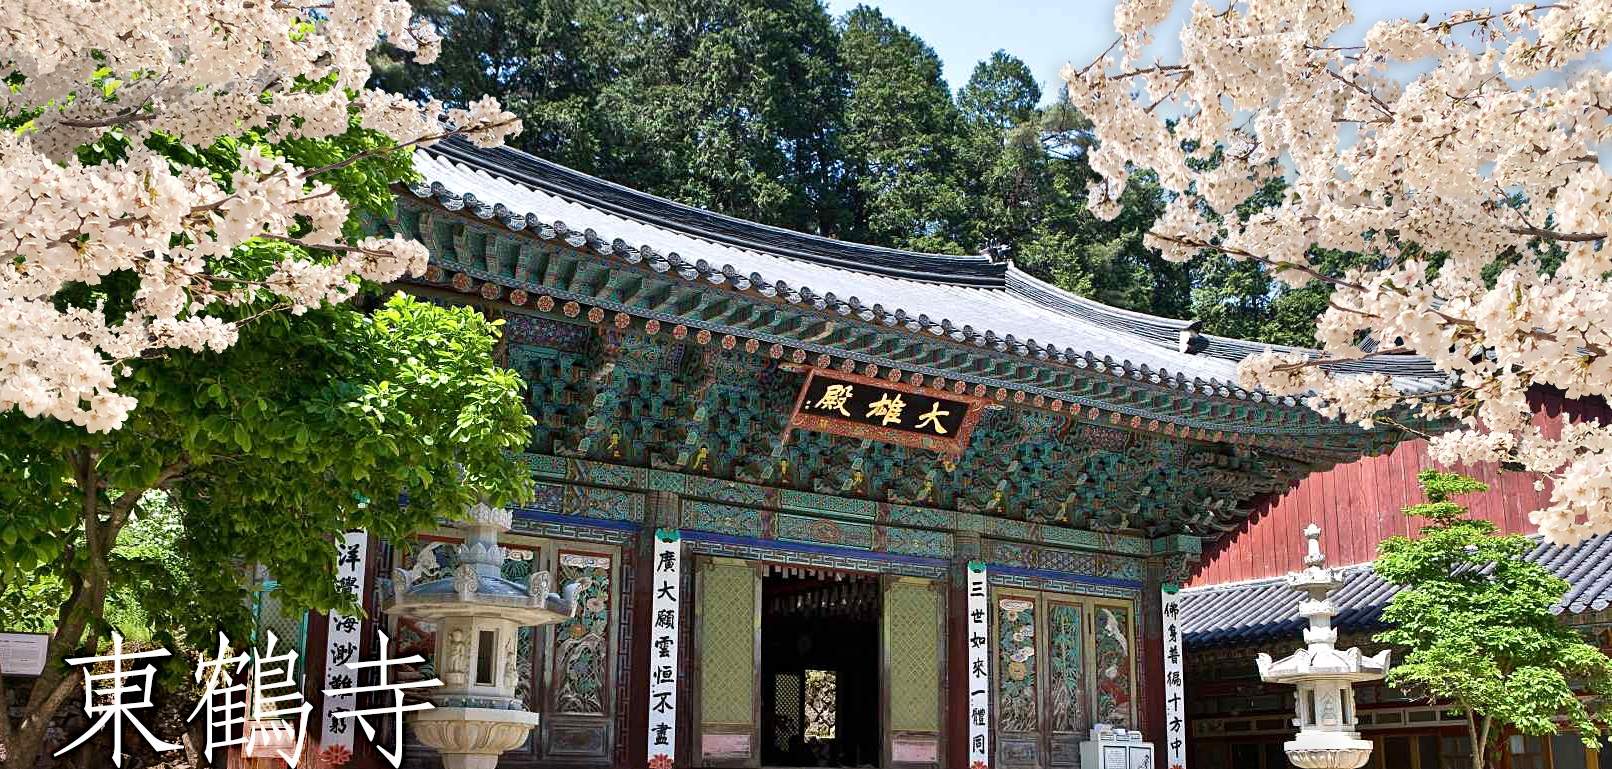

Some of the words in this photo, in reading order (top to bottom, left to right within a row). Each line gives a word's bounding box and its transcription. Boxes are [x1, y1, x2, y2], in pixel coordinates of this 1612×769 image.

[814, 384, 950, 435] 大雄殿
[970, 581, 987, 754] 三世如來一體同
